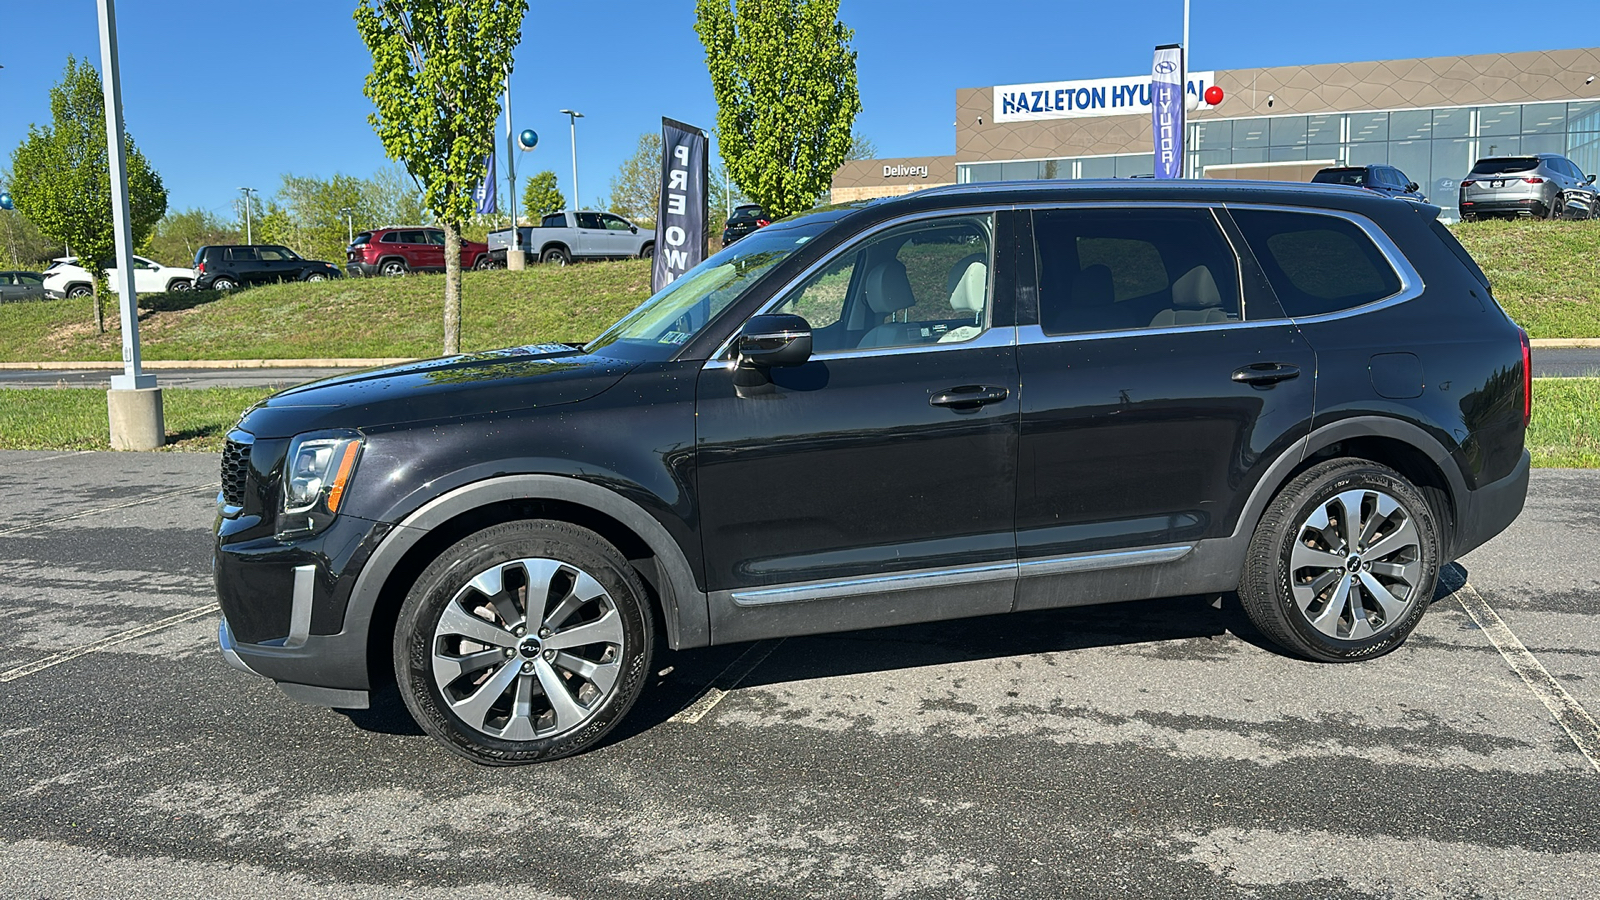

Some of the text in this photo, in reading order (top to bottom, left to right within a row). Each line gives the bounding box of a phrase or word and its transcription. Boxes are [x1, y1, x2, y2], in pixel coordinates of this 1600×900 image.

[1003, 80, 1204, 115] HAZLETON HYUAI
[1159, 88, 1173, 175] HYUNDAI
[883, 164, 928, 178] Delivery
